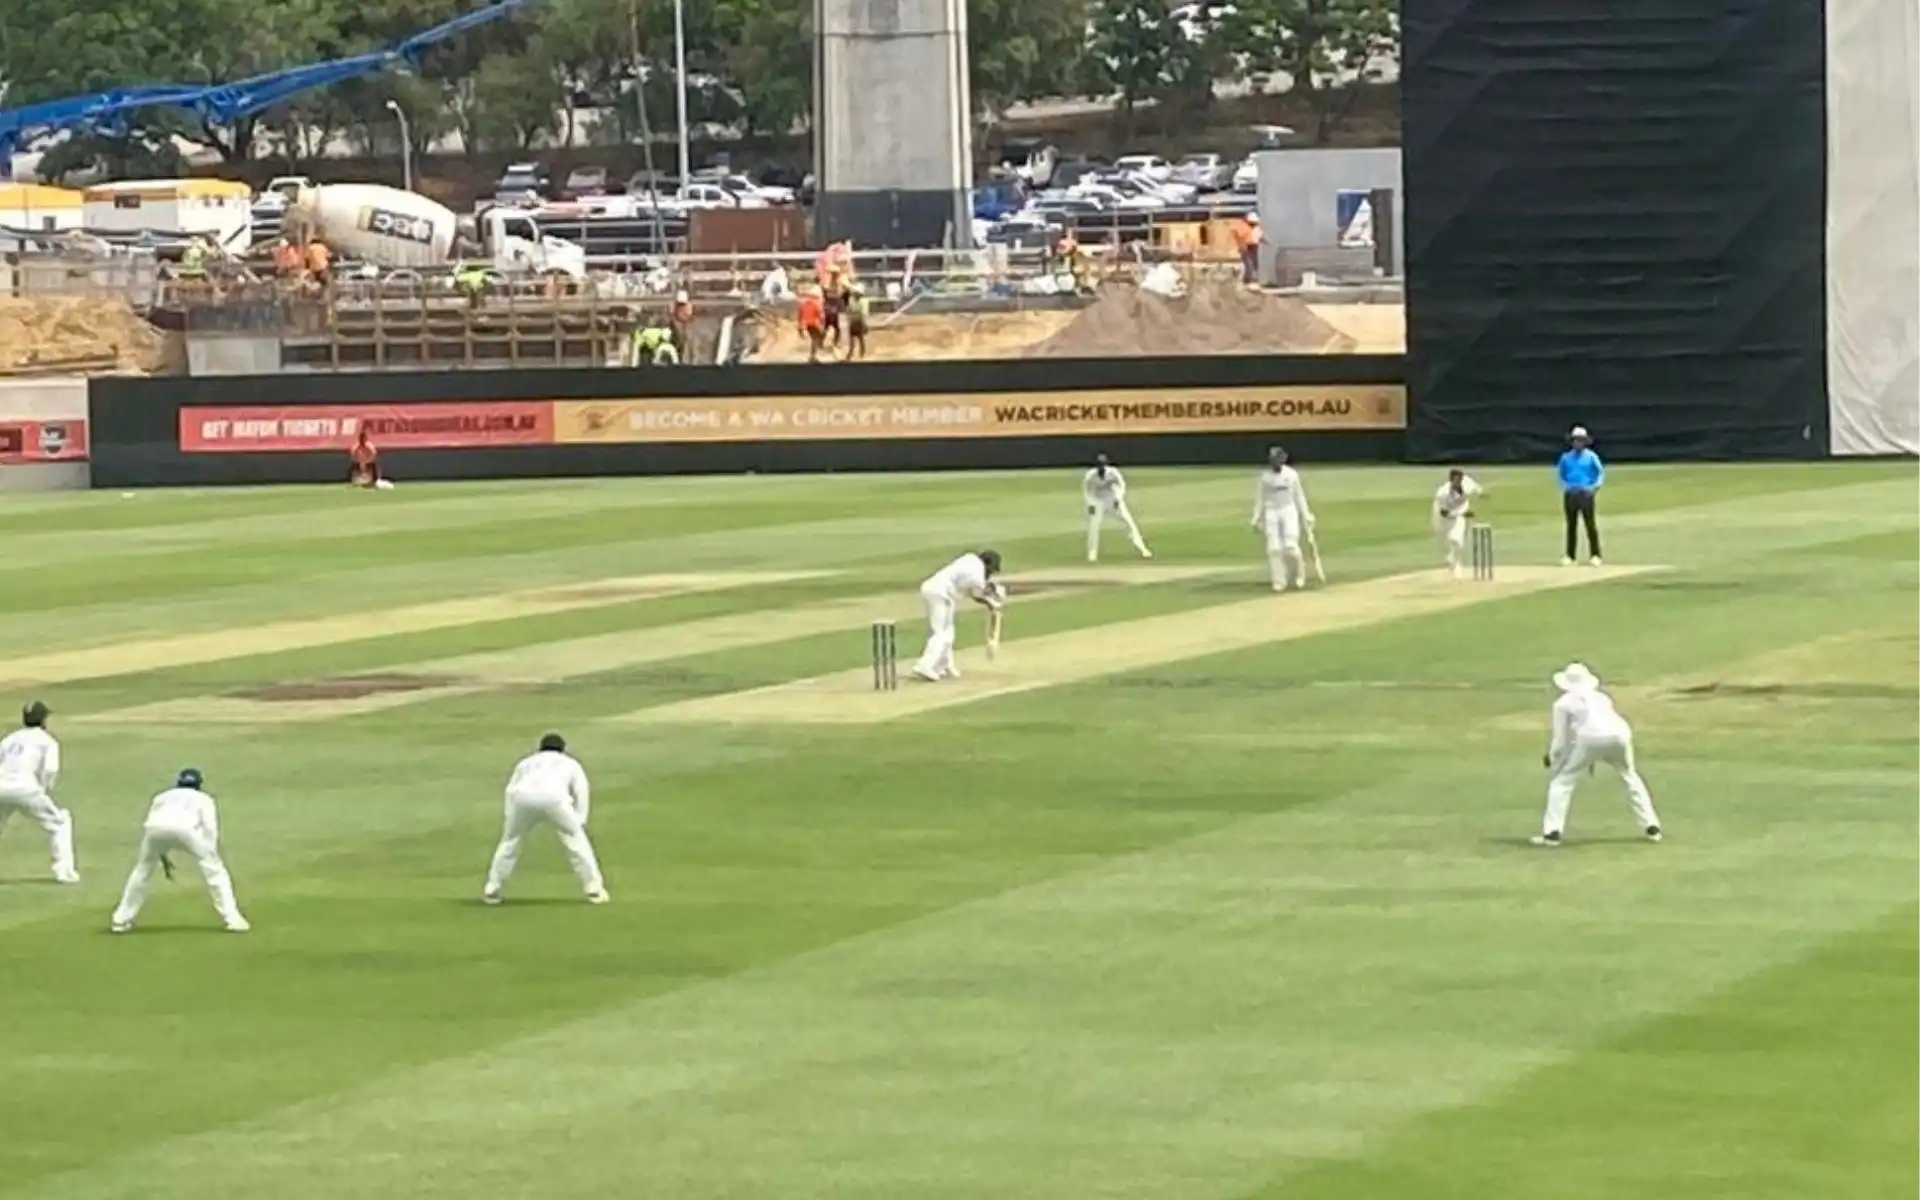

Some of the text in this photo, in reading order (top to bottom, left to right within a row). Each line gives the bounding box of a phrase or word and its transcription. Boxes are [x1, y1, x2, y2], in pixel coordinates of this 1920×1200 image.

[629, 399, 1352, 430] BECOME A WA CRICKET MEMBER WACRICKETMEMBERSHIP.COM.AU
